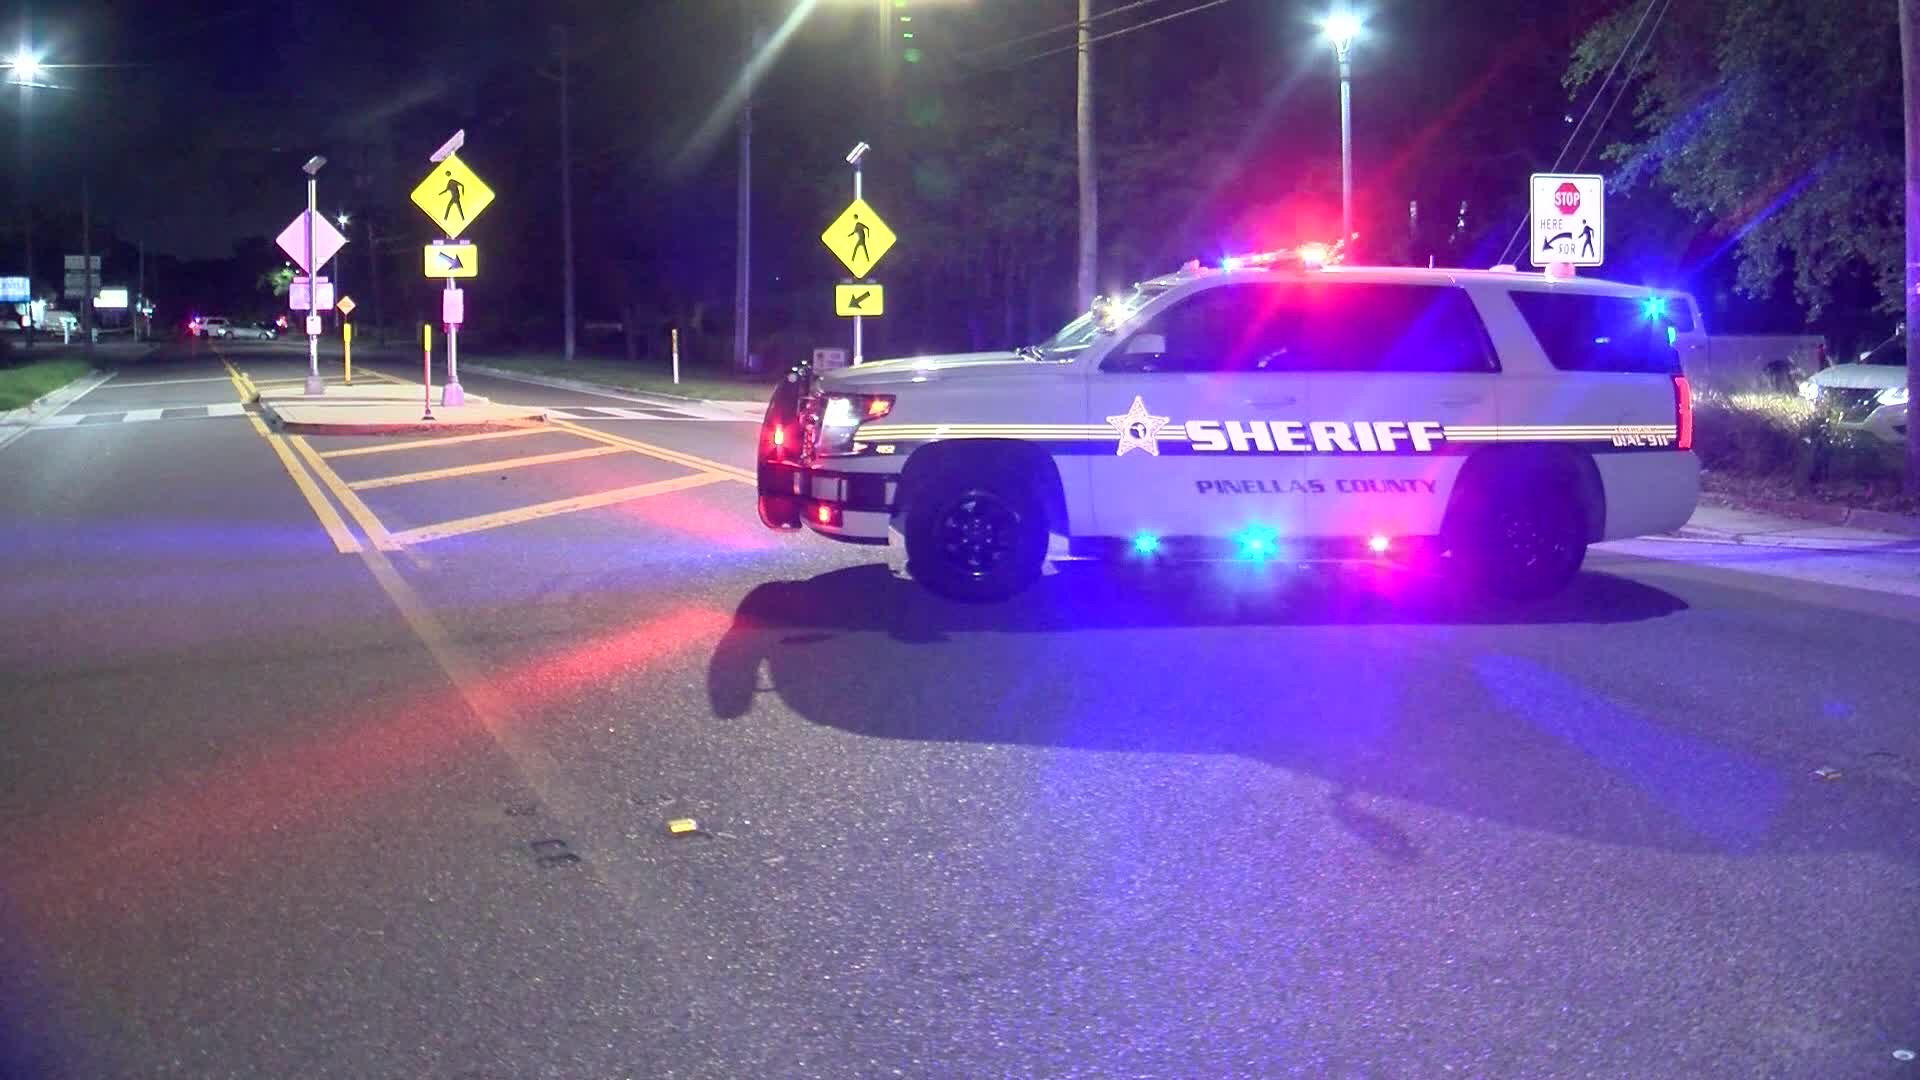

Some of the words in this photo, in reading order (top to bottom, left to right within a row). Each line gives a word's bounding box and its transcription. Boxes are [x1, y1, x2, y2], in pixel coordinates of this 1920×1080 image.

[1554, 192, 1580, 206] STOP
[1540, 219, 1563, 230] HERE
[1558, 244, 1576, 254] FOR
[1184, 420, 1444, 452] SHERIFF
[1195, 480, 1325, 494] PINELLAS
[1336, 480, 1437, 494] COUNTY
